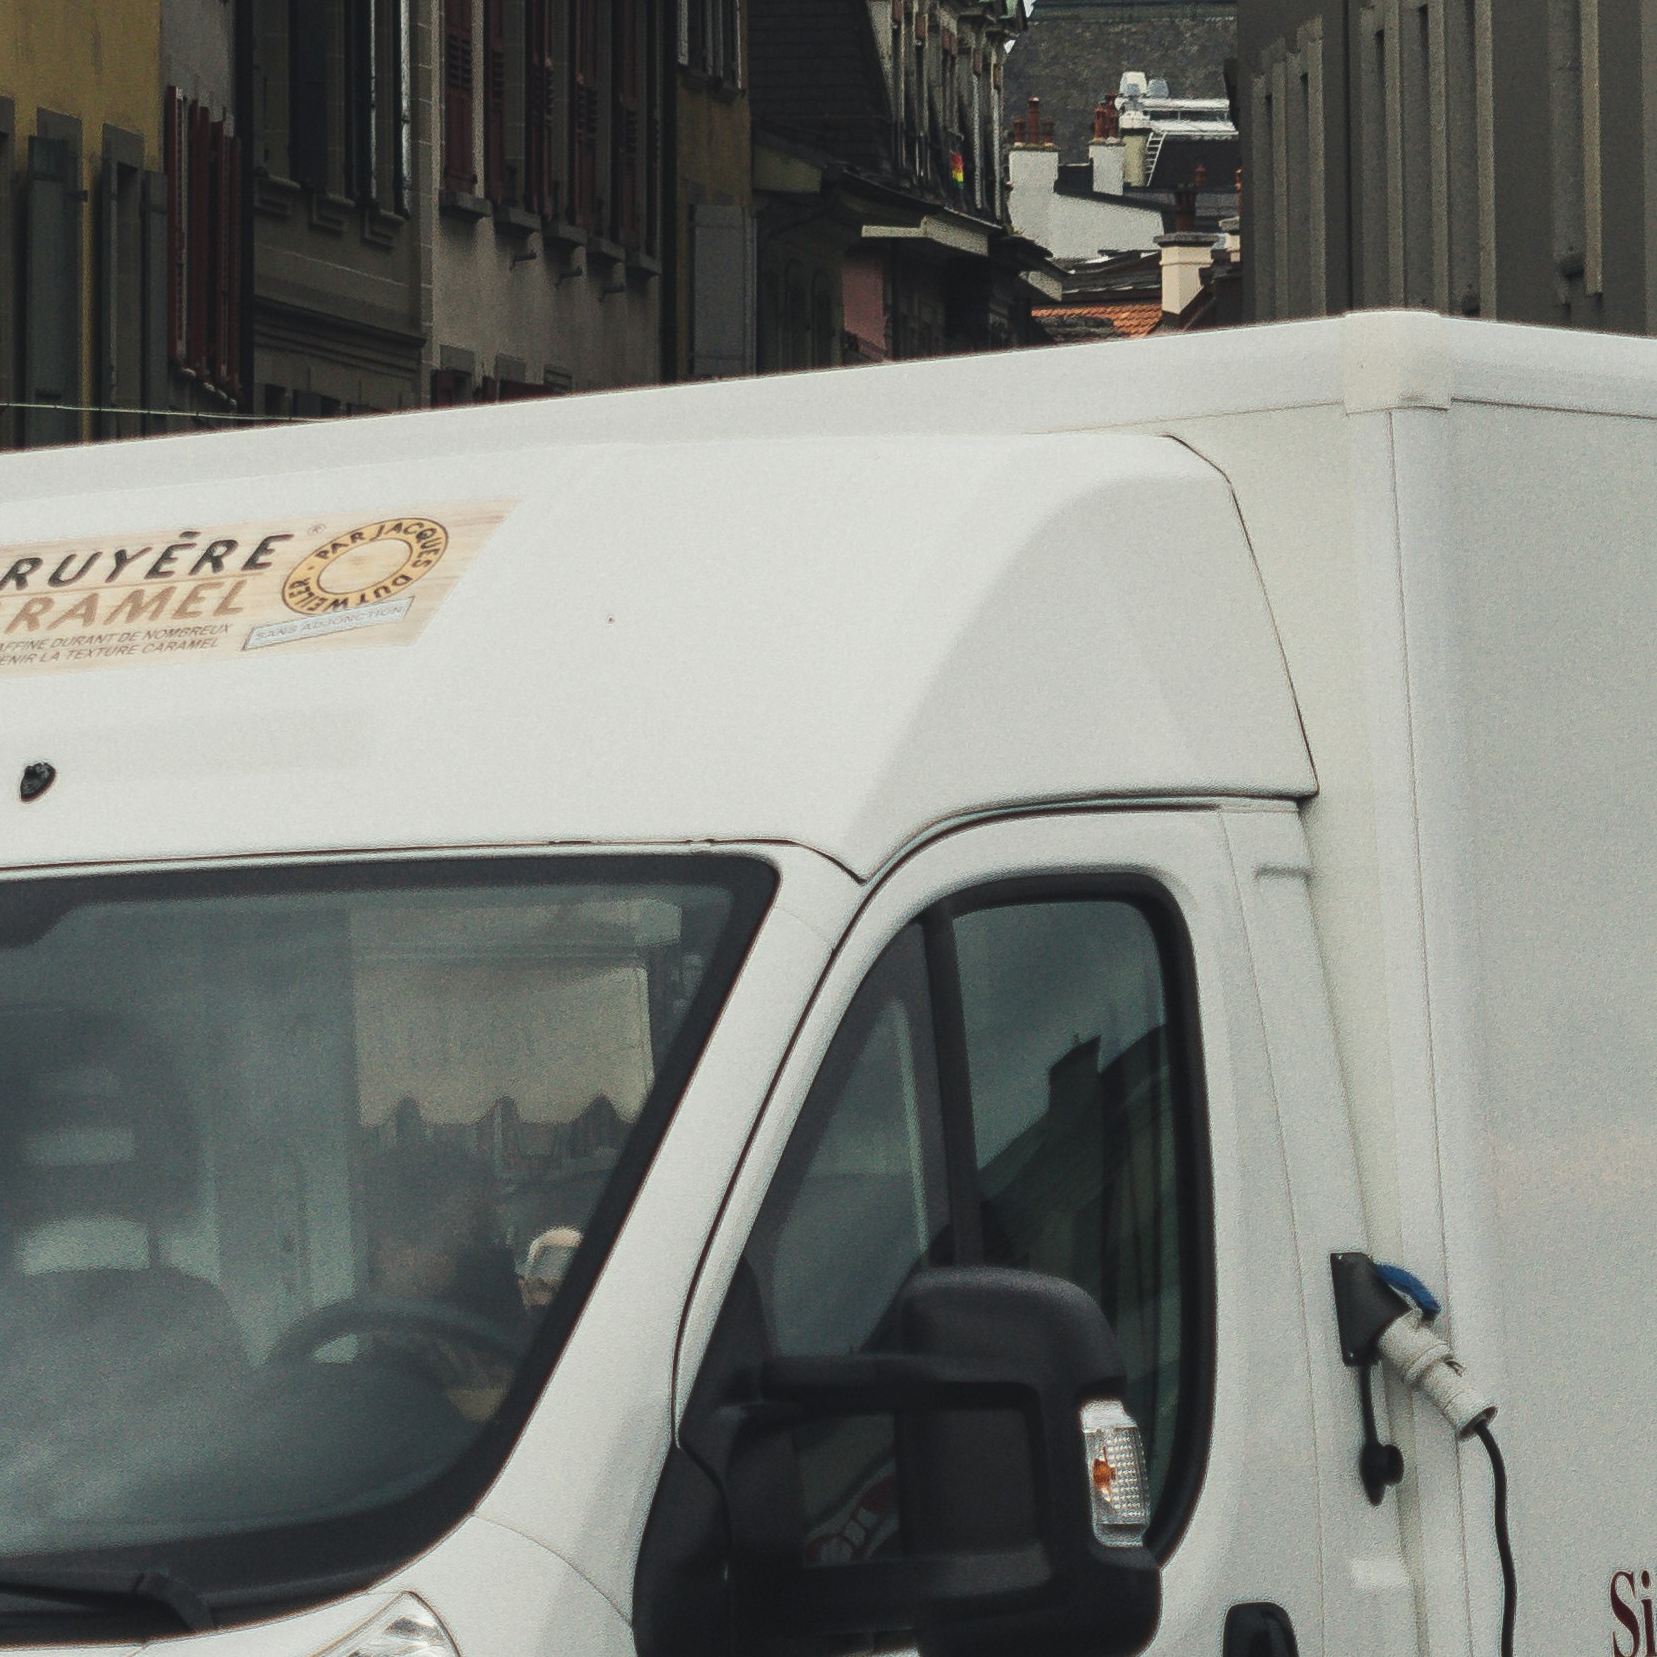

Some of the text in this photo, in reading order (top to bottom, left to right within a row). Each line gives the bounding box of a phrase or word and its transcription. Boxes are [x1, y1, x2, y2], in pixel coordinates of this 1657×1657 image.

[314, 521, 442, 570] PAR JACQUES
[67, 644, 141, 660] TEXTURE
[141, 637, 220, 654] CARAMEL
[141, 623, 234, 640] NOMBREUX
[1610, 1569, 1657, 1657] Si
